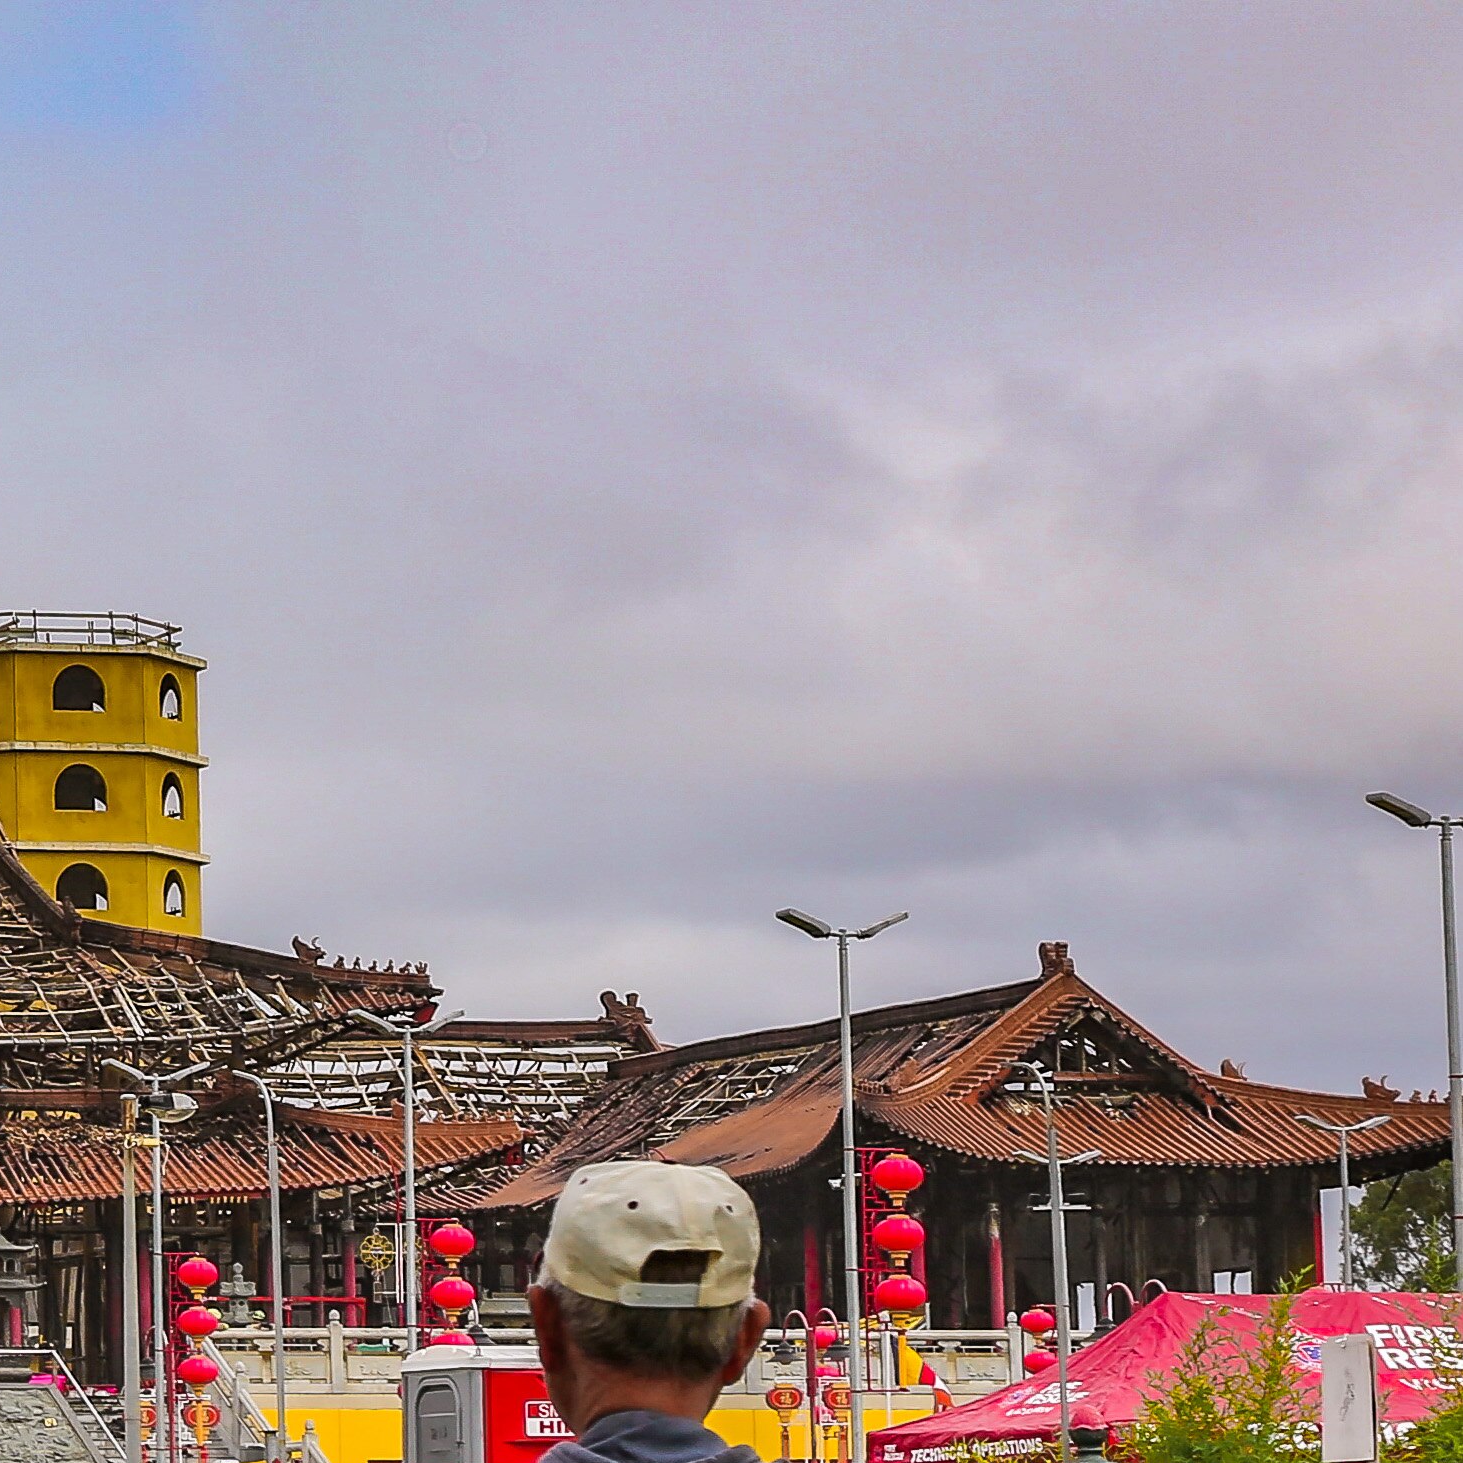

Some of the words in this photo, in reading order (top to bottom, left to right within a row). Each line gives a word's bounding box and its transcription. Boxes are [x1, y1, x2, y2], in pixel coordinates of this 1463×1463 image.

[1365, 1325, 1463, 1348] FIRE
[911, 1446, 970, 1463] TECHNICAL
[971, 1438, 1044, 1457] OPERATIONS
